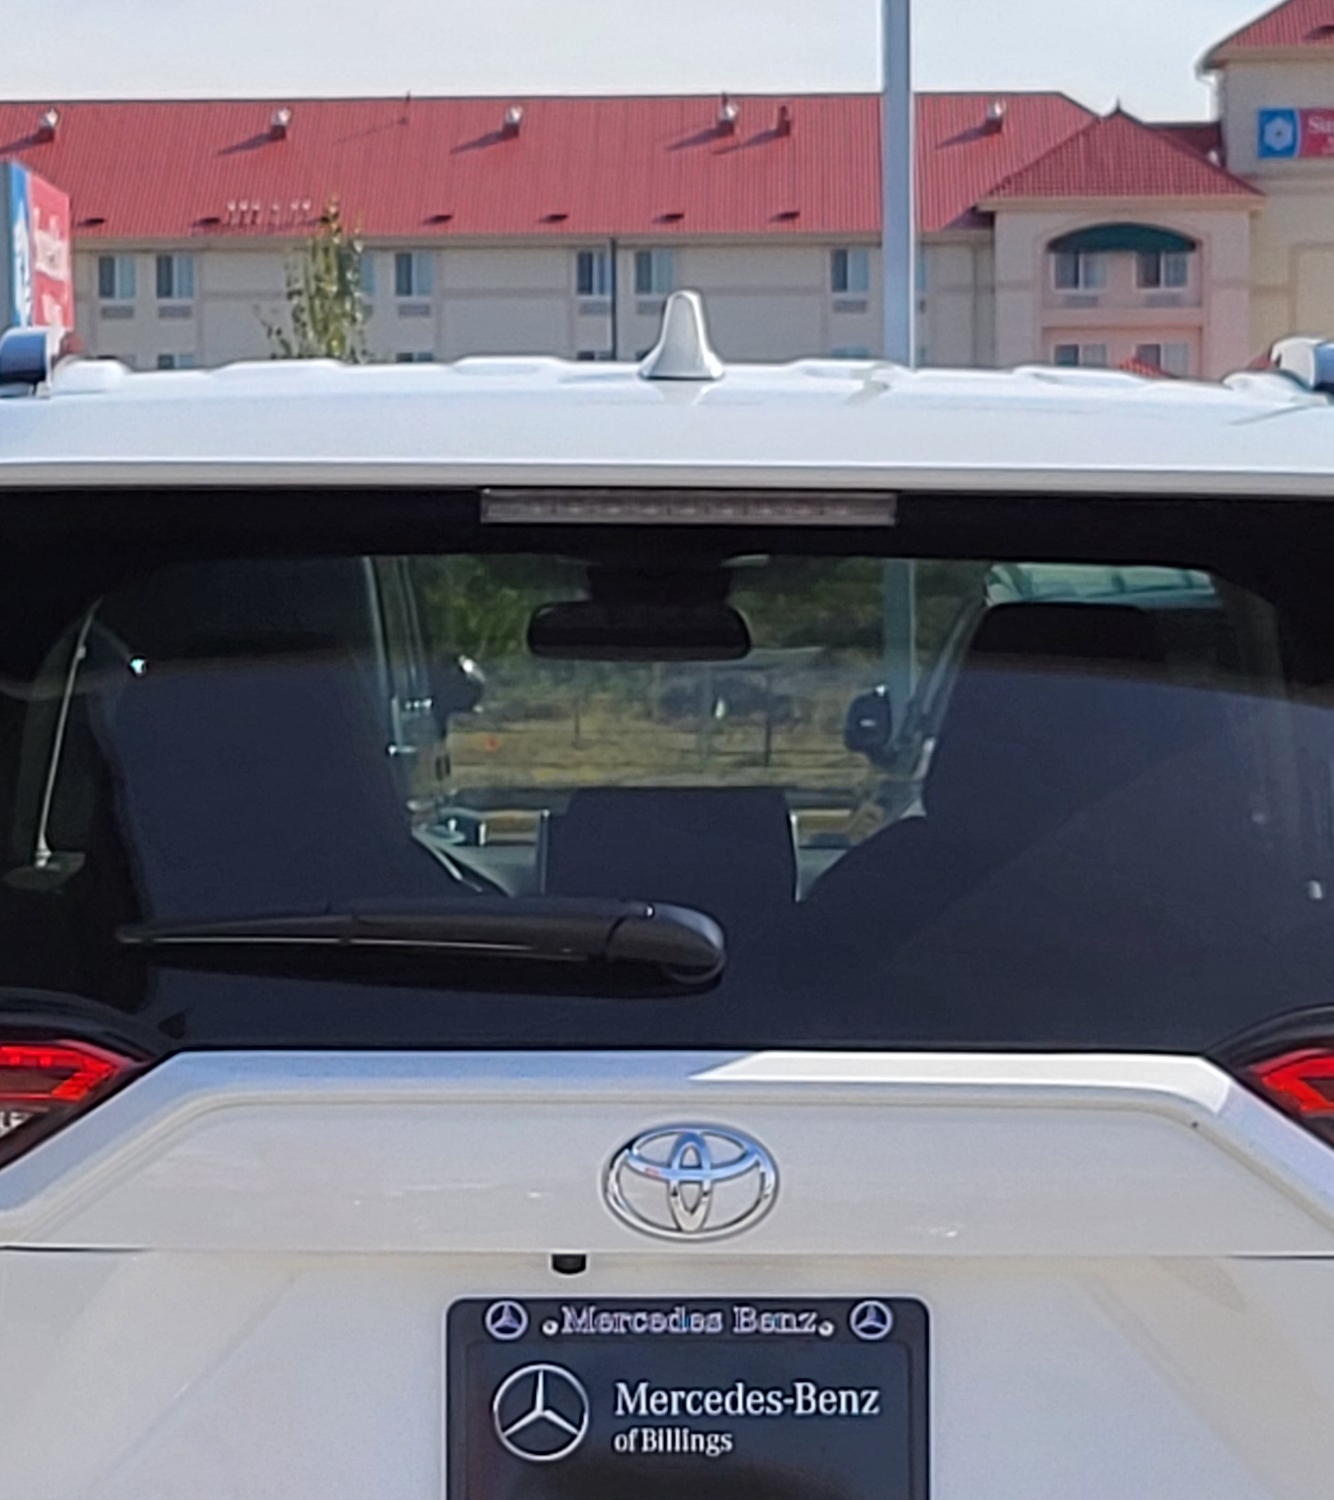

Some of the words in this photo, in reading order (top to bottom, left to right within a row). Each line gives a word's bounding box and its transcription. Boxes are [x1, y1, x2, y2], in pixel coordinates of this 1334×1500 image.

[561, 1305, 723, 1335] Mercedes
[732, 1305, 819, 1335] Benz
[614, 1382, 880, 1416] Mercedes-Benz
[613, 1427, 640, 1452] of
[641, 1428, 733, 1457] Billings
